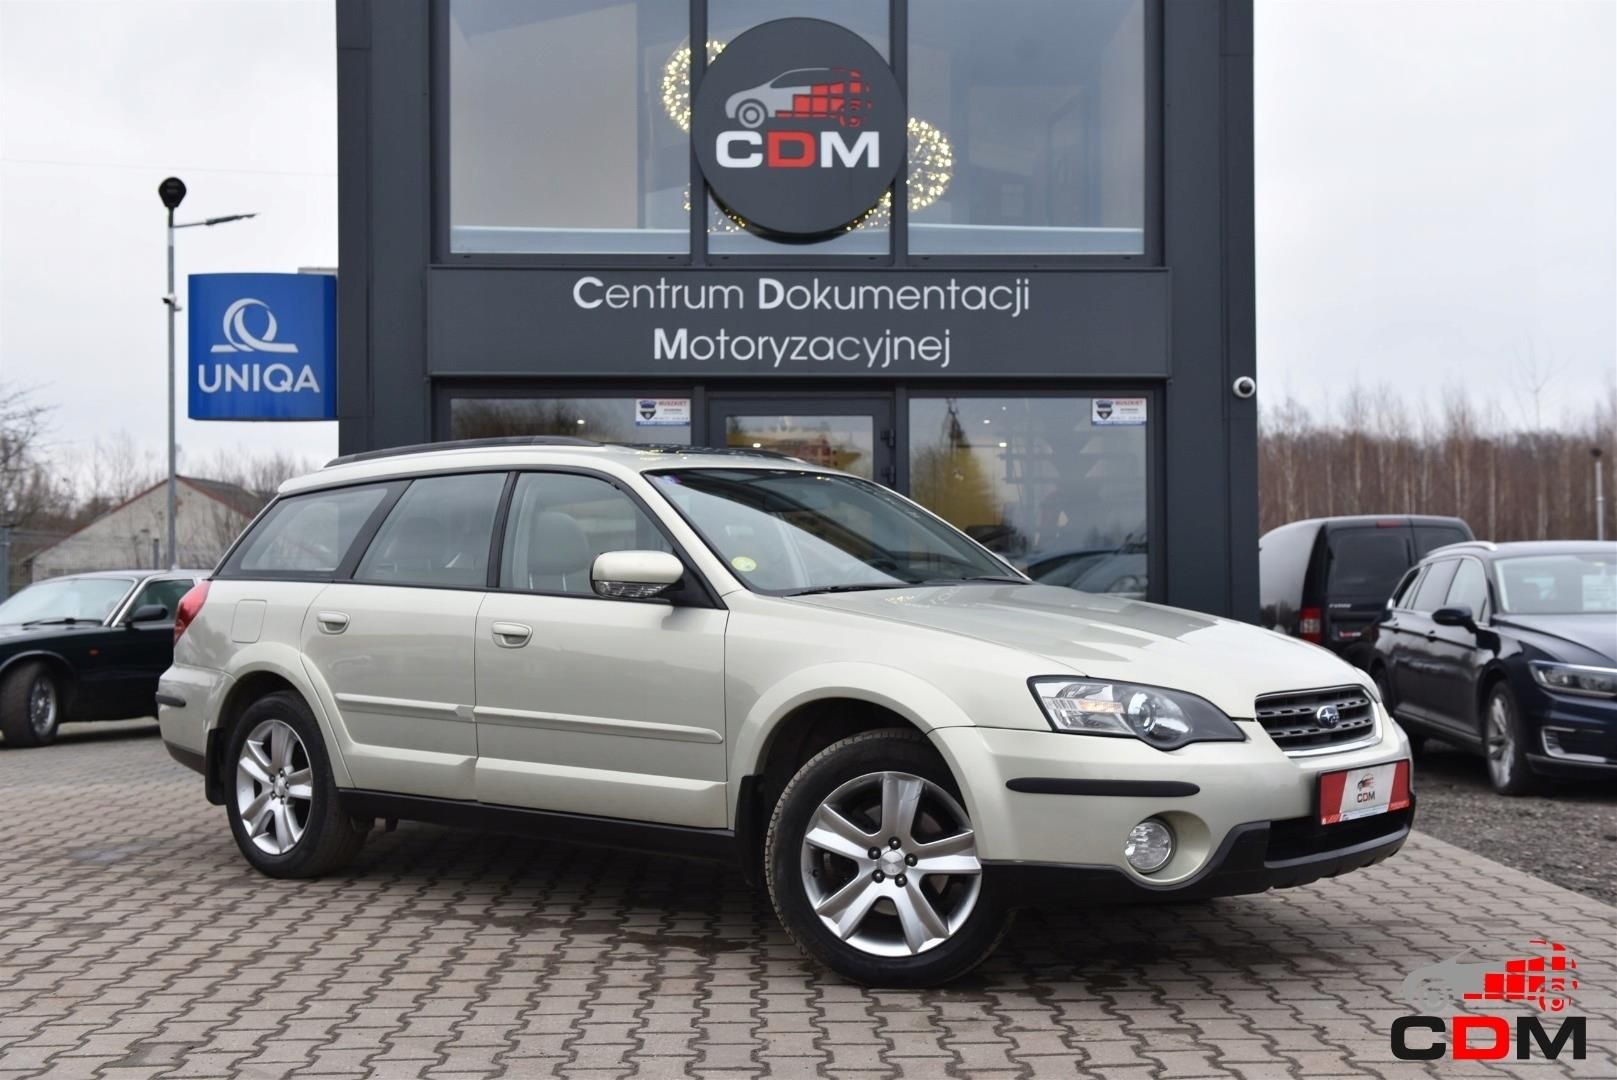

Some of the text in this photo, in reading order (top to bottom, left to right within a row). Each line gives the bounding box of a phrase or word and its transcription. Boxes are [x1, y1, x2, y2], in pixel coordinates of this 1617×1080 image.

[715, 131, 880, 168] CDM
[572, 277, 1030, 317] Centrum Dokumentacji
[653, 328, 951, 367] Motoryzacyjnej
[198, 363, 320, 393] UNIQA
[1357, 791, 1376, 803] CDM
